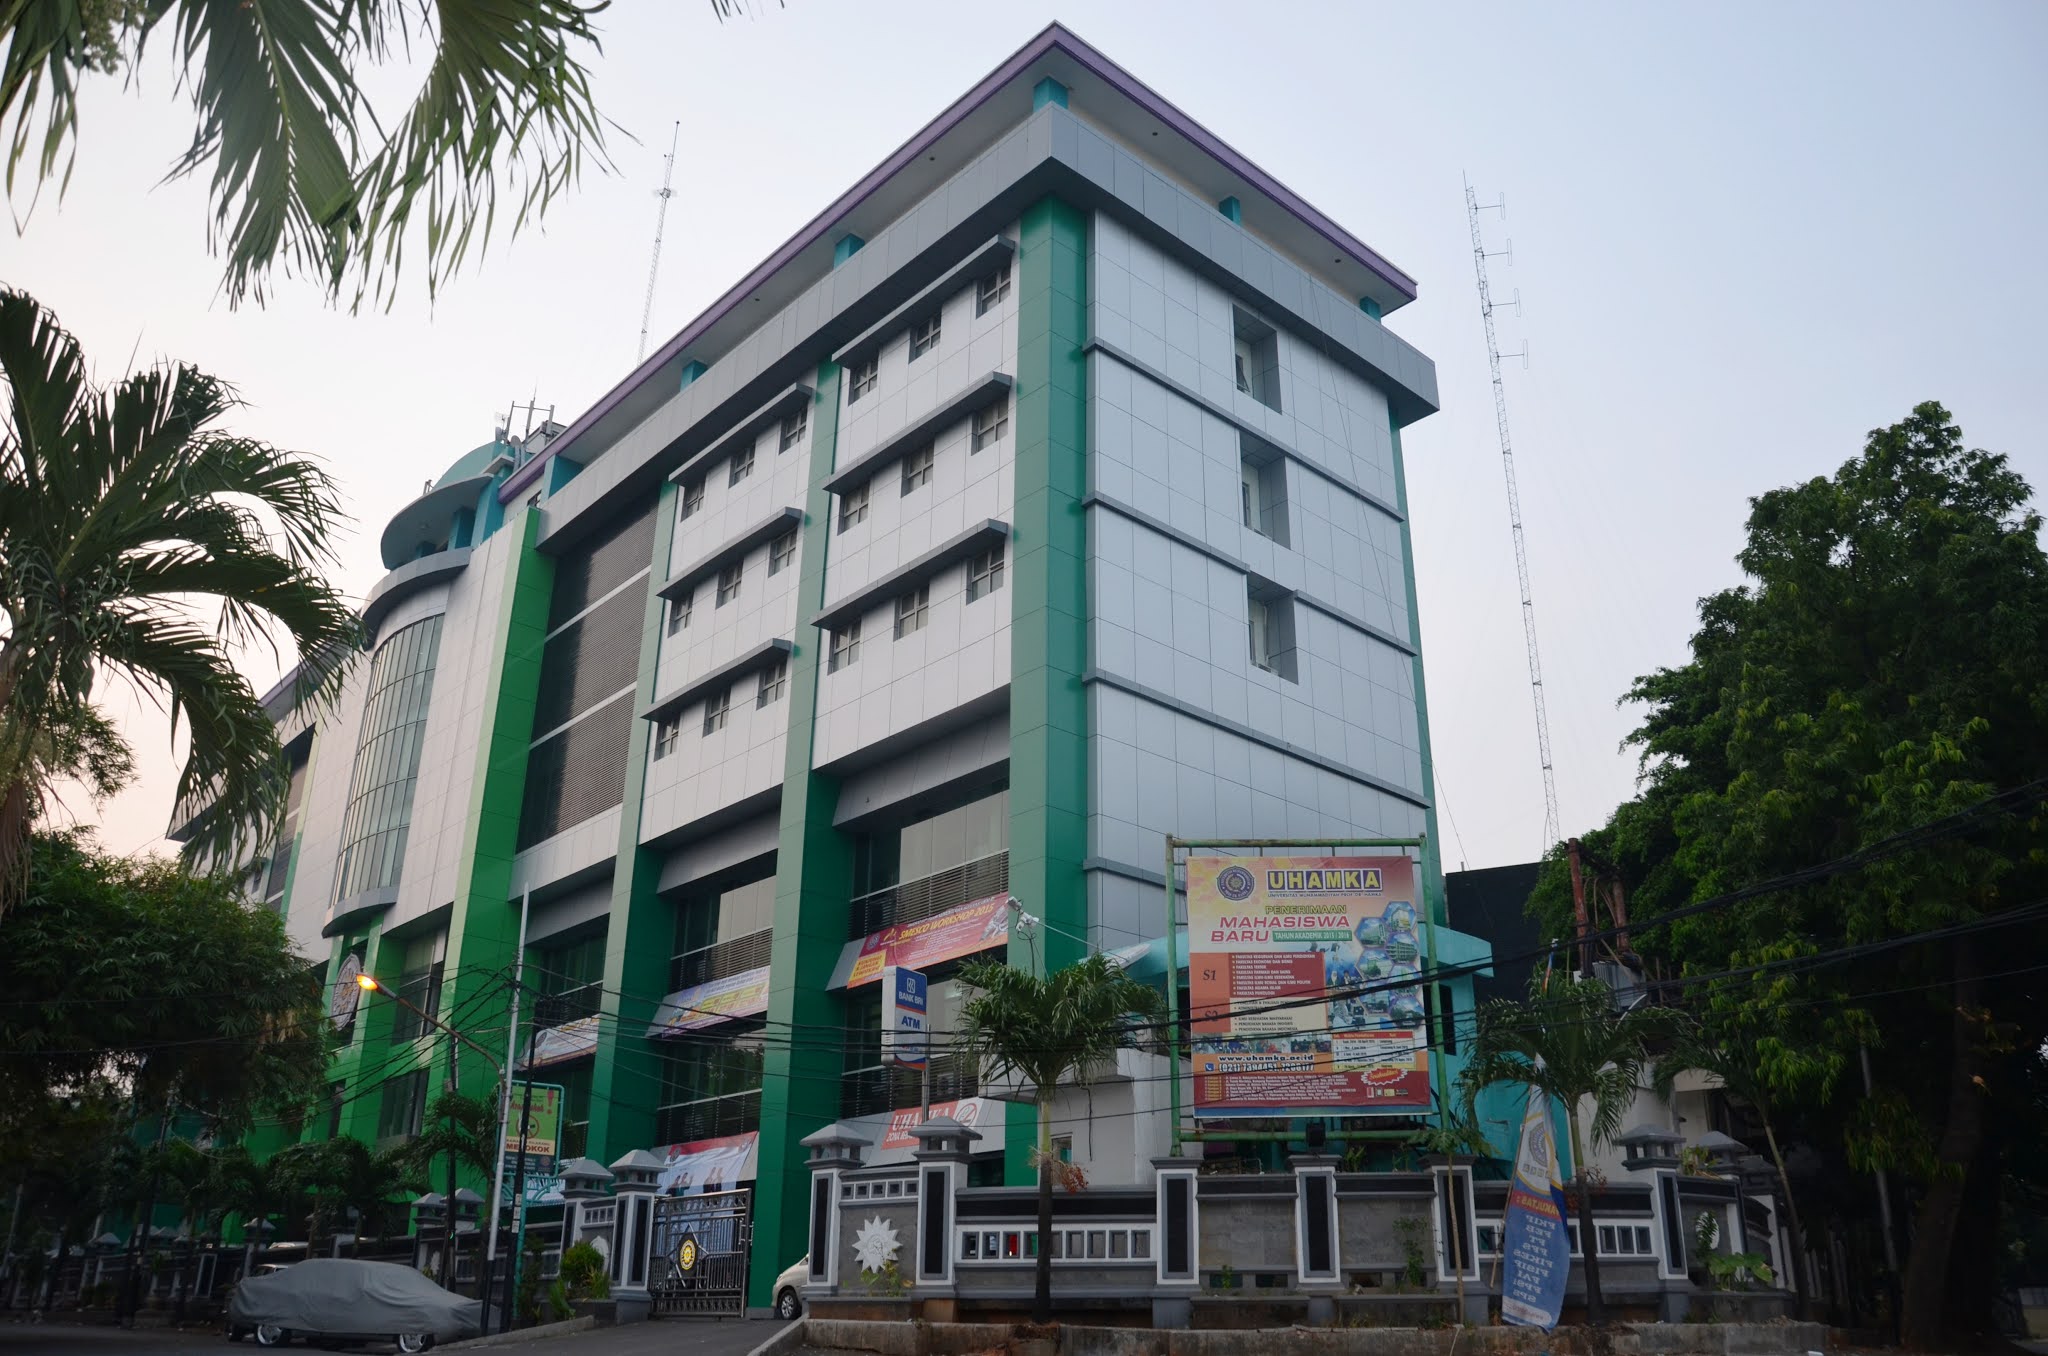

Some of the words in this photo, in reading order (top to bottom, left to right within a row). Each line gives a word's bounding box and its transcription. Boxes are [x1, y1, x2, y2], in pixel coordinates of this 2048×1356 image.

[1269, 870, 1380, 890] UHAMKA
[1264, 904, 1347, 914] PENERIMAAN
[899, 925, 930, 940] SMESCO
[930, 910, 975, 930] WORKSHOP
[974, 902, 995, 917] 2015
[1219, 916, 1350, 928] MAHASISWA
[1210, 930, 1269, 942] BARU
[1274, 932, 1294, 940] TAHUN
[1202, 970, 1216, 980] S1
[898, 990, 914, 1003] BANK
[914, 995, 924, 1005] BRI
[901, 1016, 920, 1030] ATM
[1219, 1063, 1240, 1072] (021)
[506, 1143, 550, 1153] MEOKOK
